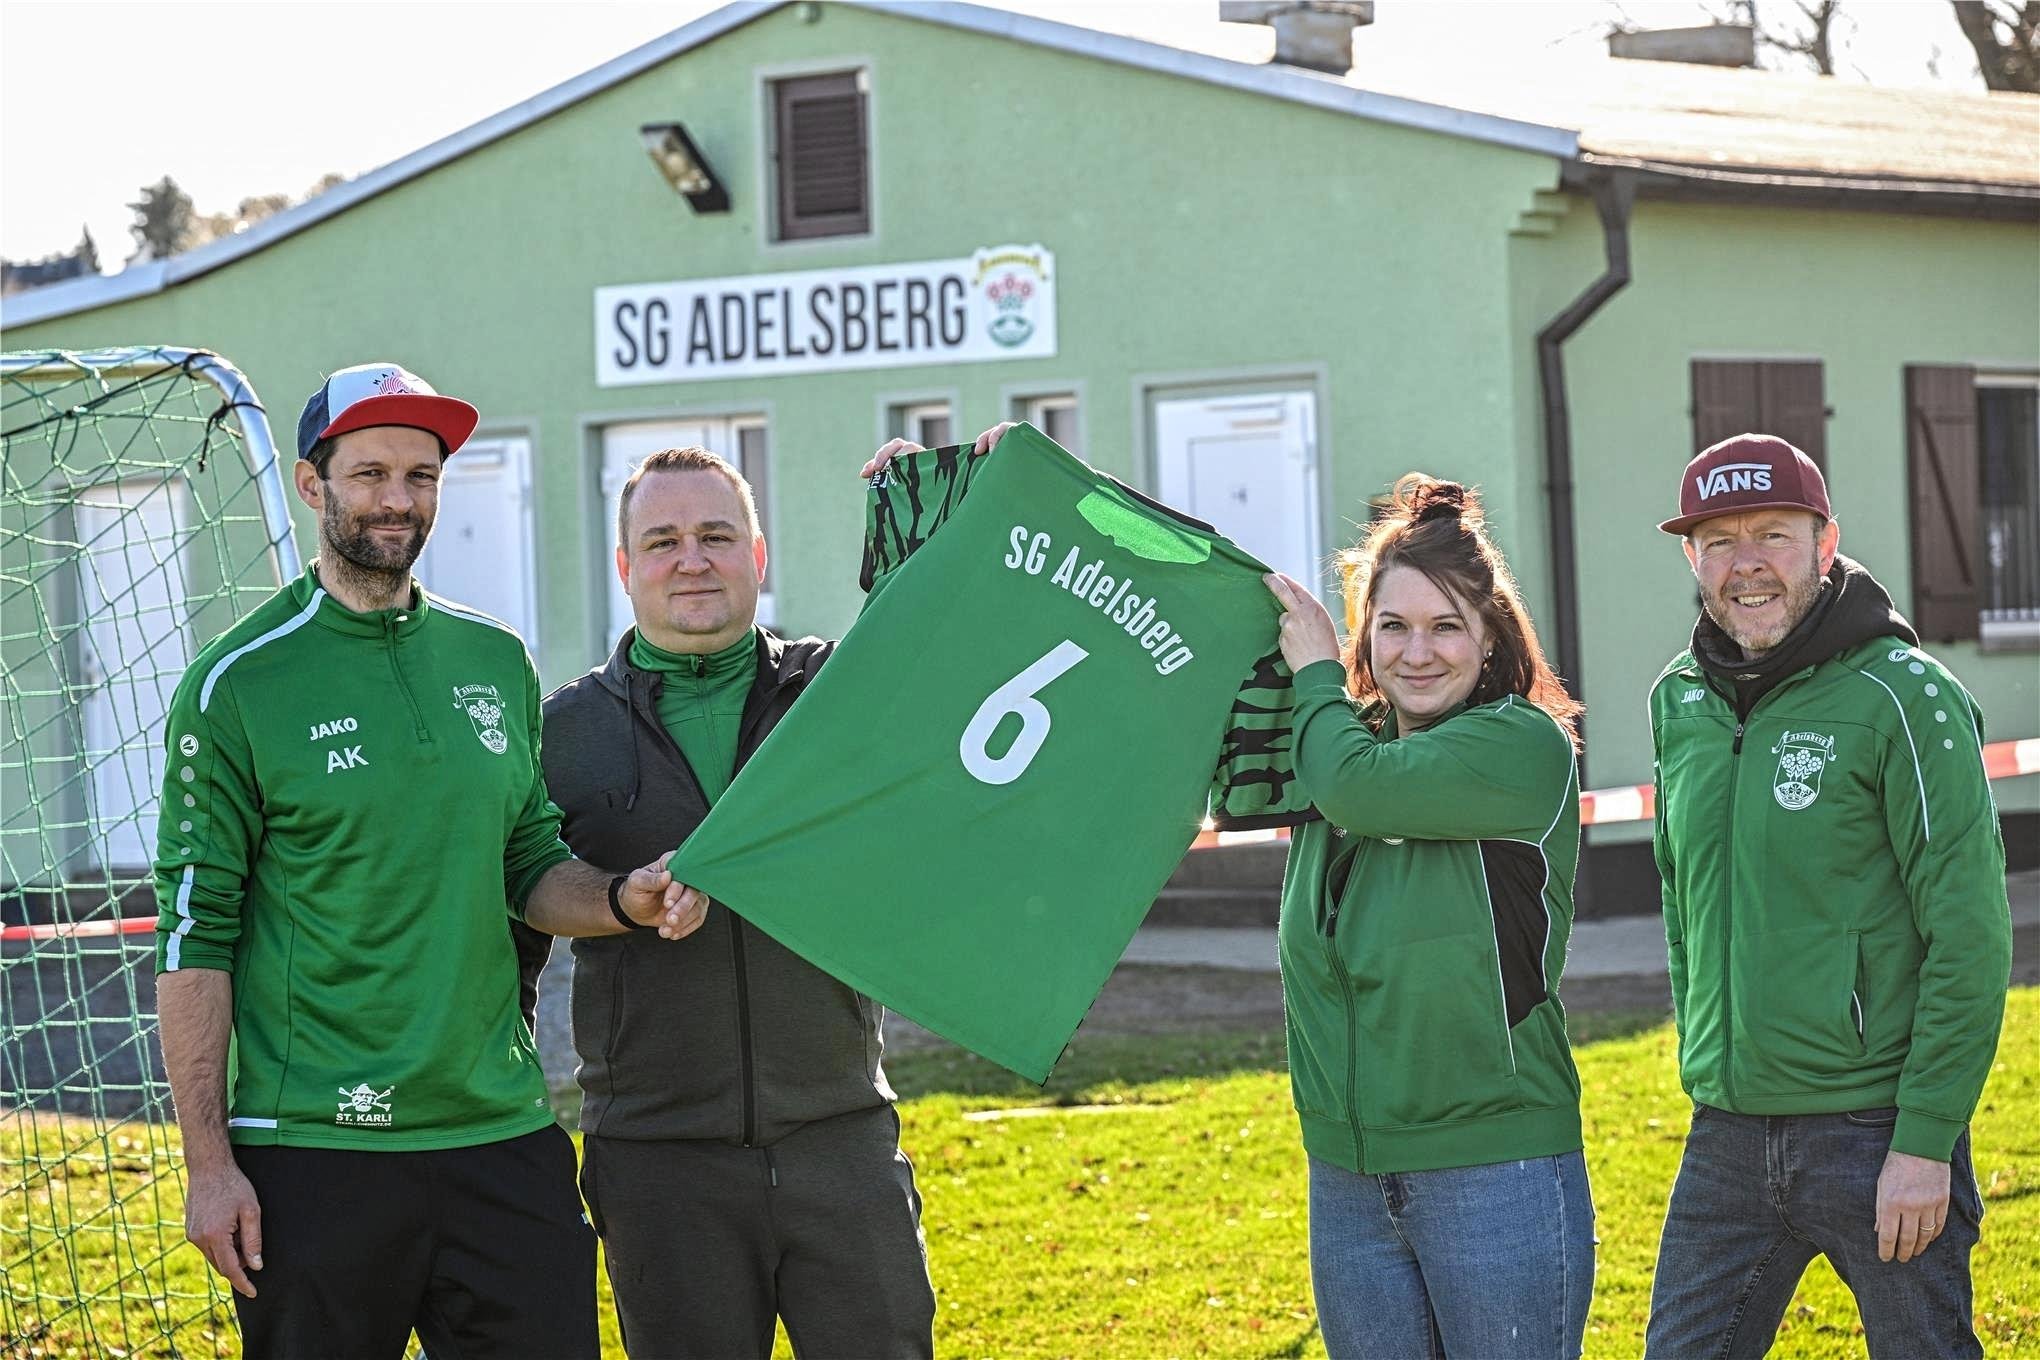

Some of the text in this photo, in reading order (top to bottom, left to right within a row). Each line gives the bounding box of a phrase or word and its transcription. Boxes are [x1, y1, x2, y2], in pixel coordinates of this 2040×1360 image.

[614, 274, 967, 369] SG ADELSBERG
[1696, 463, 1773, 501] VANS
[1005, 525, 1194, 676] SG Adelsberg
[959, 638, 1090, 785] 6
[1680, 688, 1705, 704] JAKO
[310, 717, 358, 741] JAKO
[327, 744, 370, 774] AK
[335, 1112, 392, 1123] ST. KARLI
